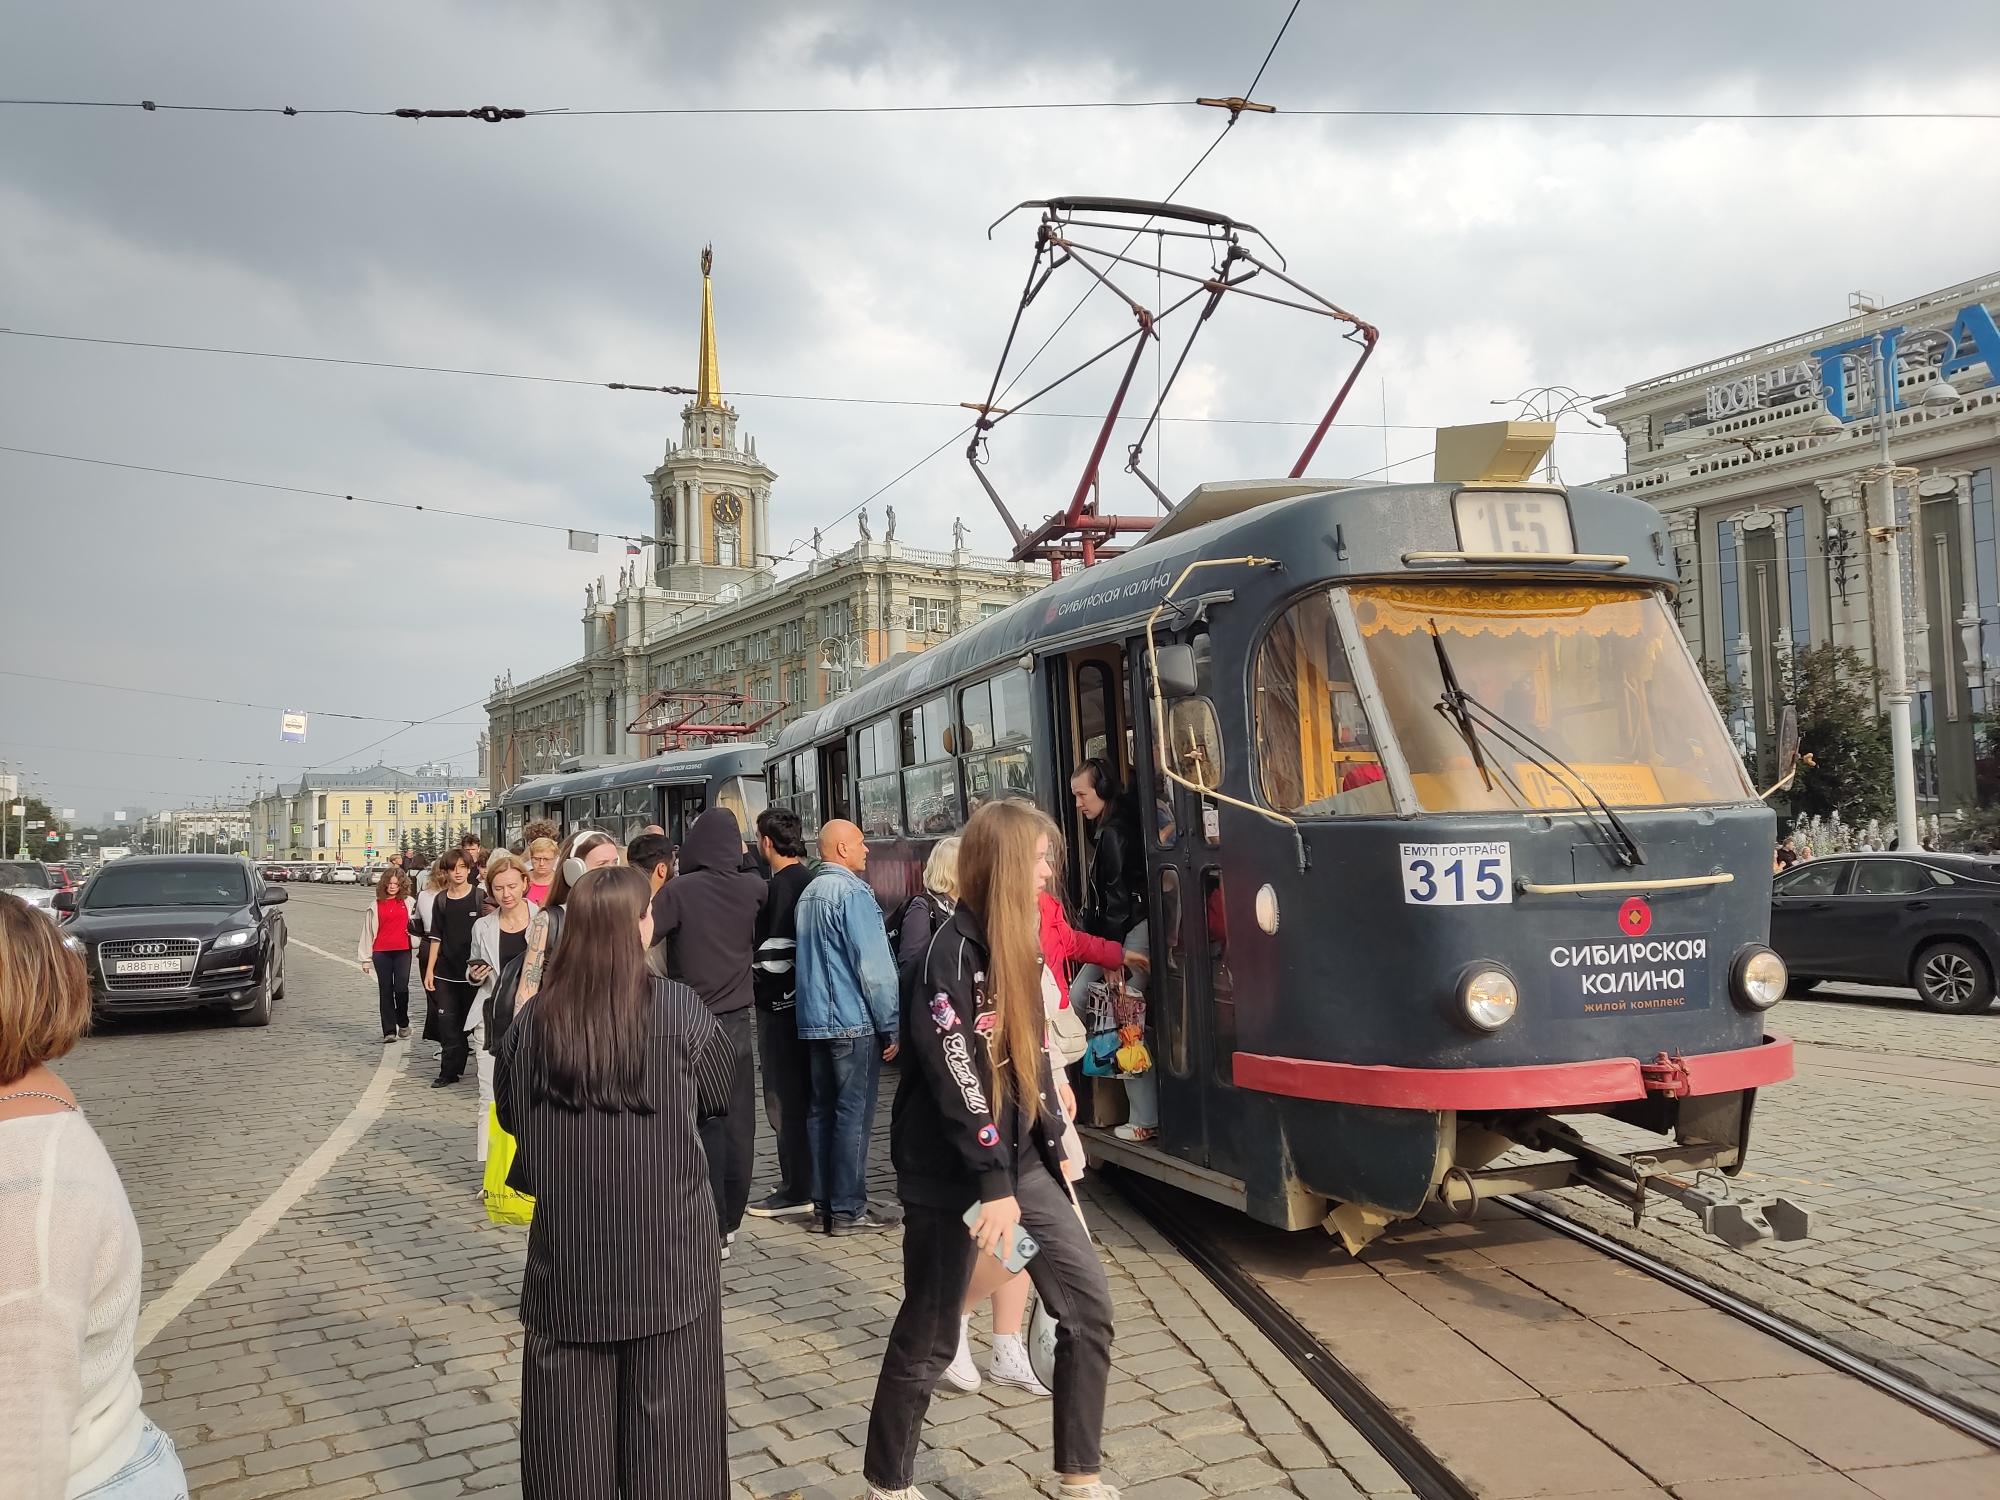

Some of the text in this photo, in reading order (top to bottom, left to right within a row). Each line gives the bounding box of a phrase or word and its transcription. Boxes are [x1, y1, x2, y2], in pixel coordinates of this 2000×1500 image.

[1478, 502, 1550, 552] 15
[1403, 844, 1507, 857] ЕМУП ГОРТРАНС
[1409, 858, 1505, 902] 315
[1584, 996, 1686, 1013] жилой комплекс
